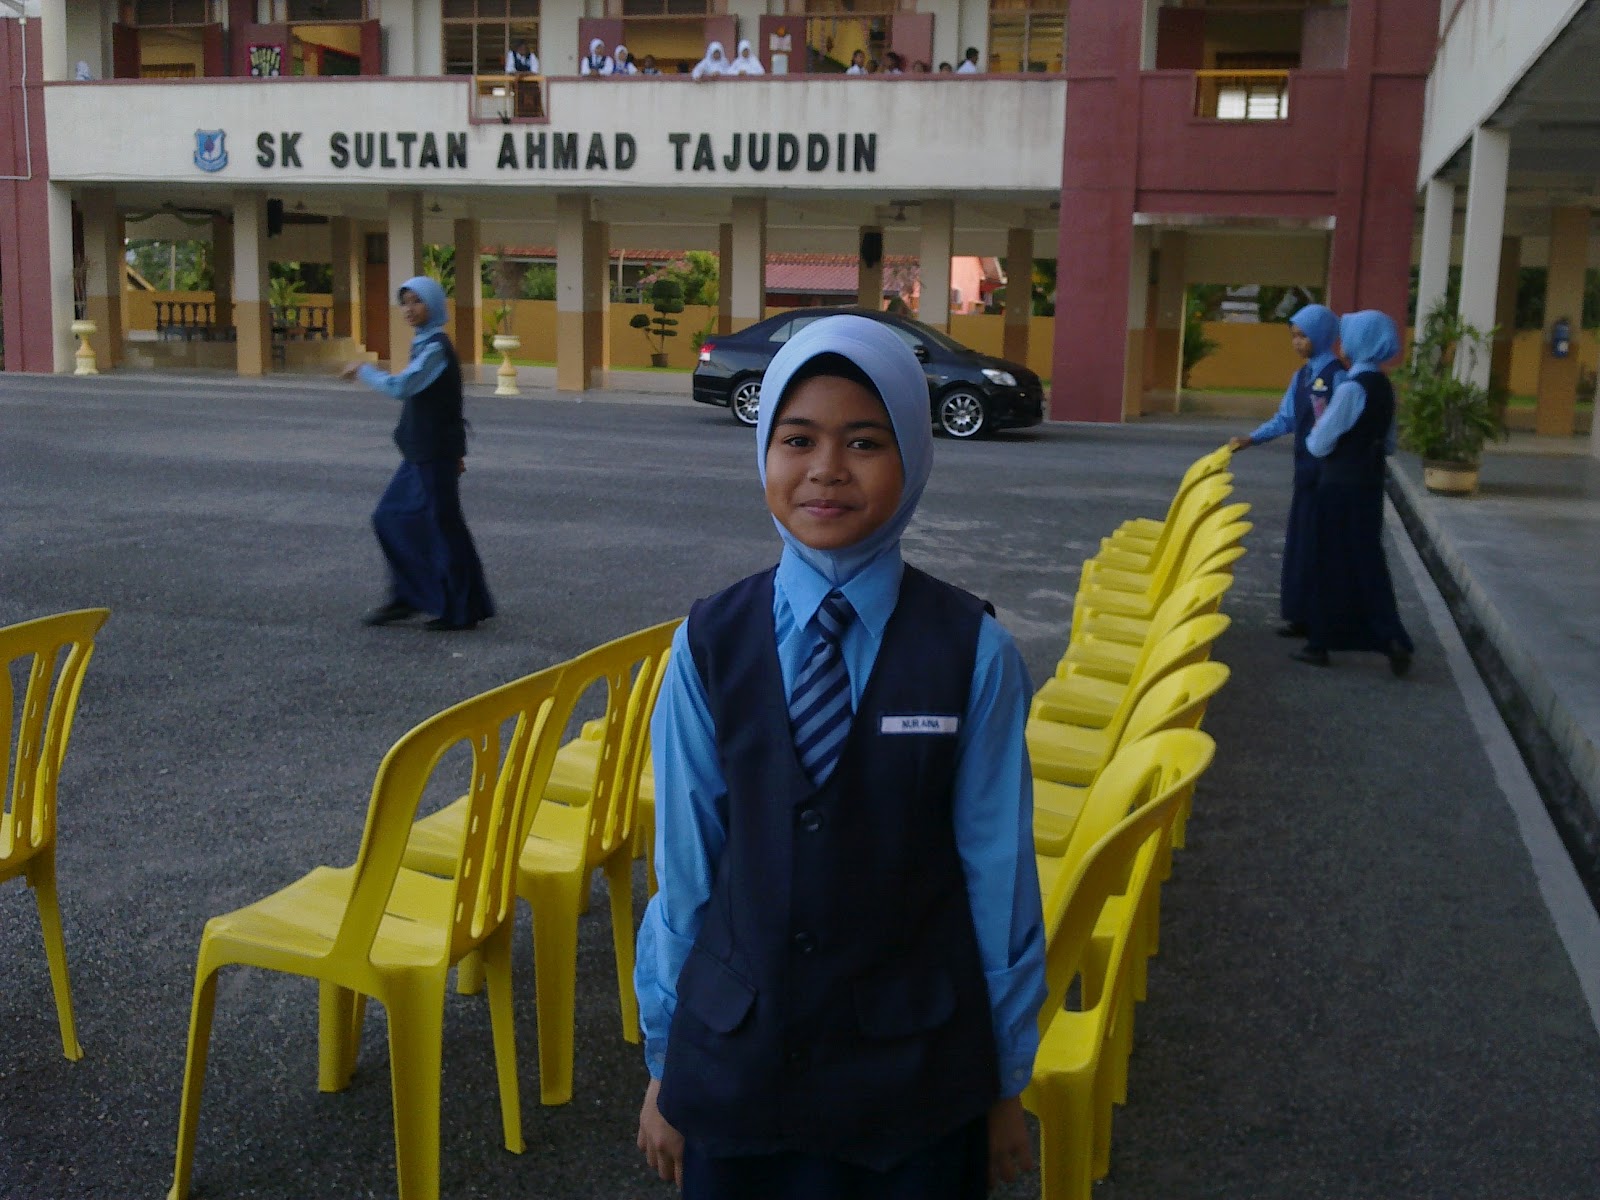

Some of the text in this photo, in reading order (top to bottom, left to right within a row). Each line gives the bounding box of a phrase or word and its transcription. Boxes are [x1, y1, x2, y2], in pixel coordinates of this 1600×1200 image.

[256, 131, 877, 172] SK SULTAN AHMAD TAJUDDIN
[902, 719, 919, 729] NUR
